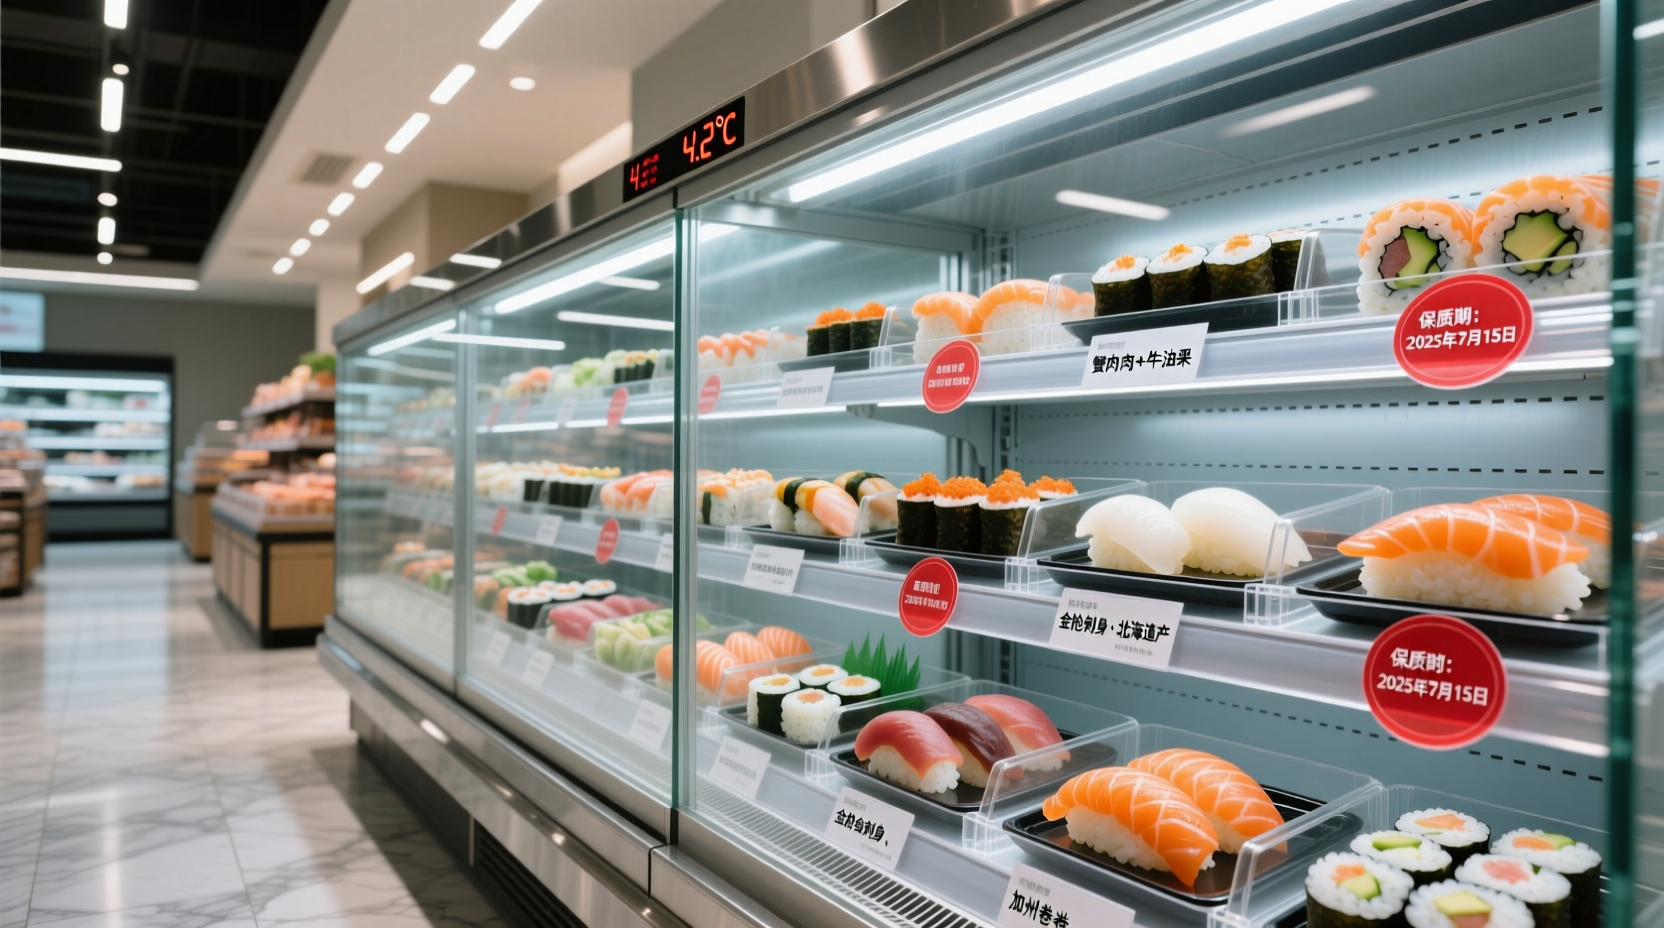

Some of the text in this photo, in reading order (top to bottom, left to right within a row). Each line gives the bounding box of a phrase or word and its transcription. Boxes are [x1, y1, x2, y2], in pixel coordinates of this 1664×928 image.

[1405, 326, 1516, 350] 2025年7月15日
[1376, 672, 1488, 706] 2025年7月15日
